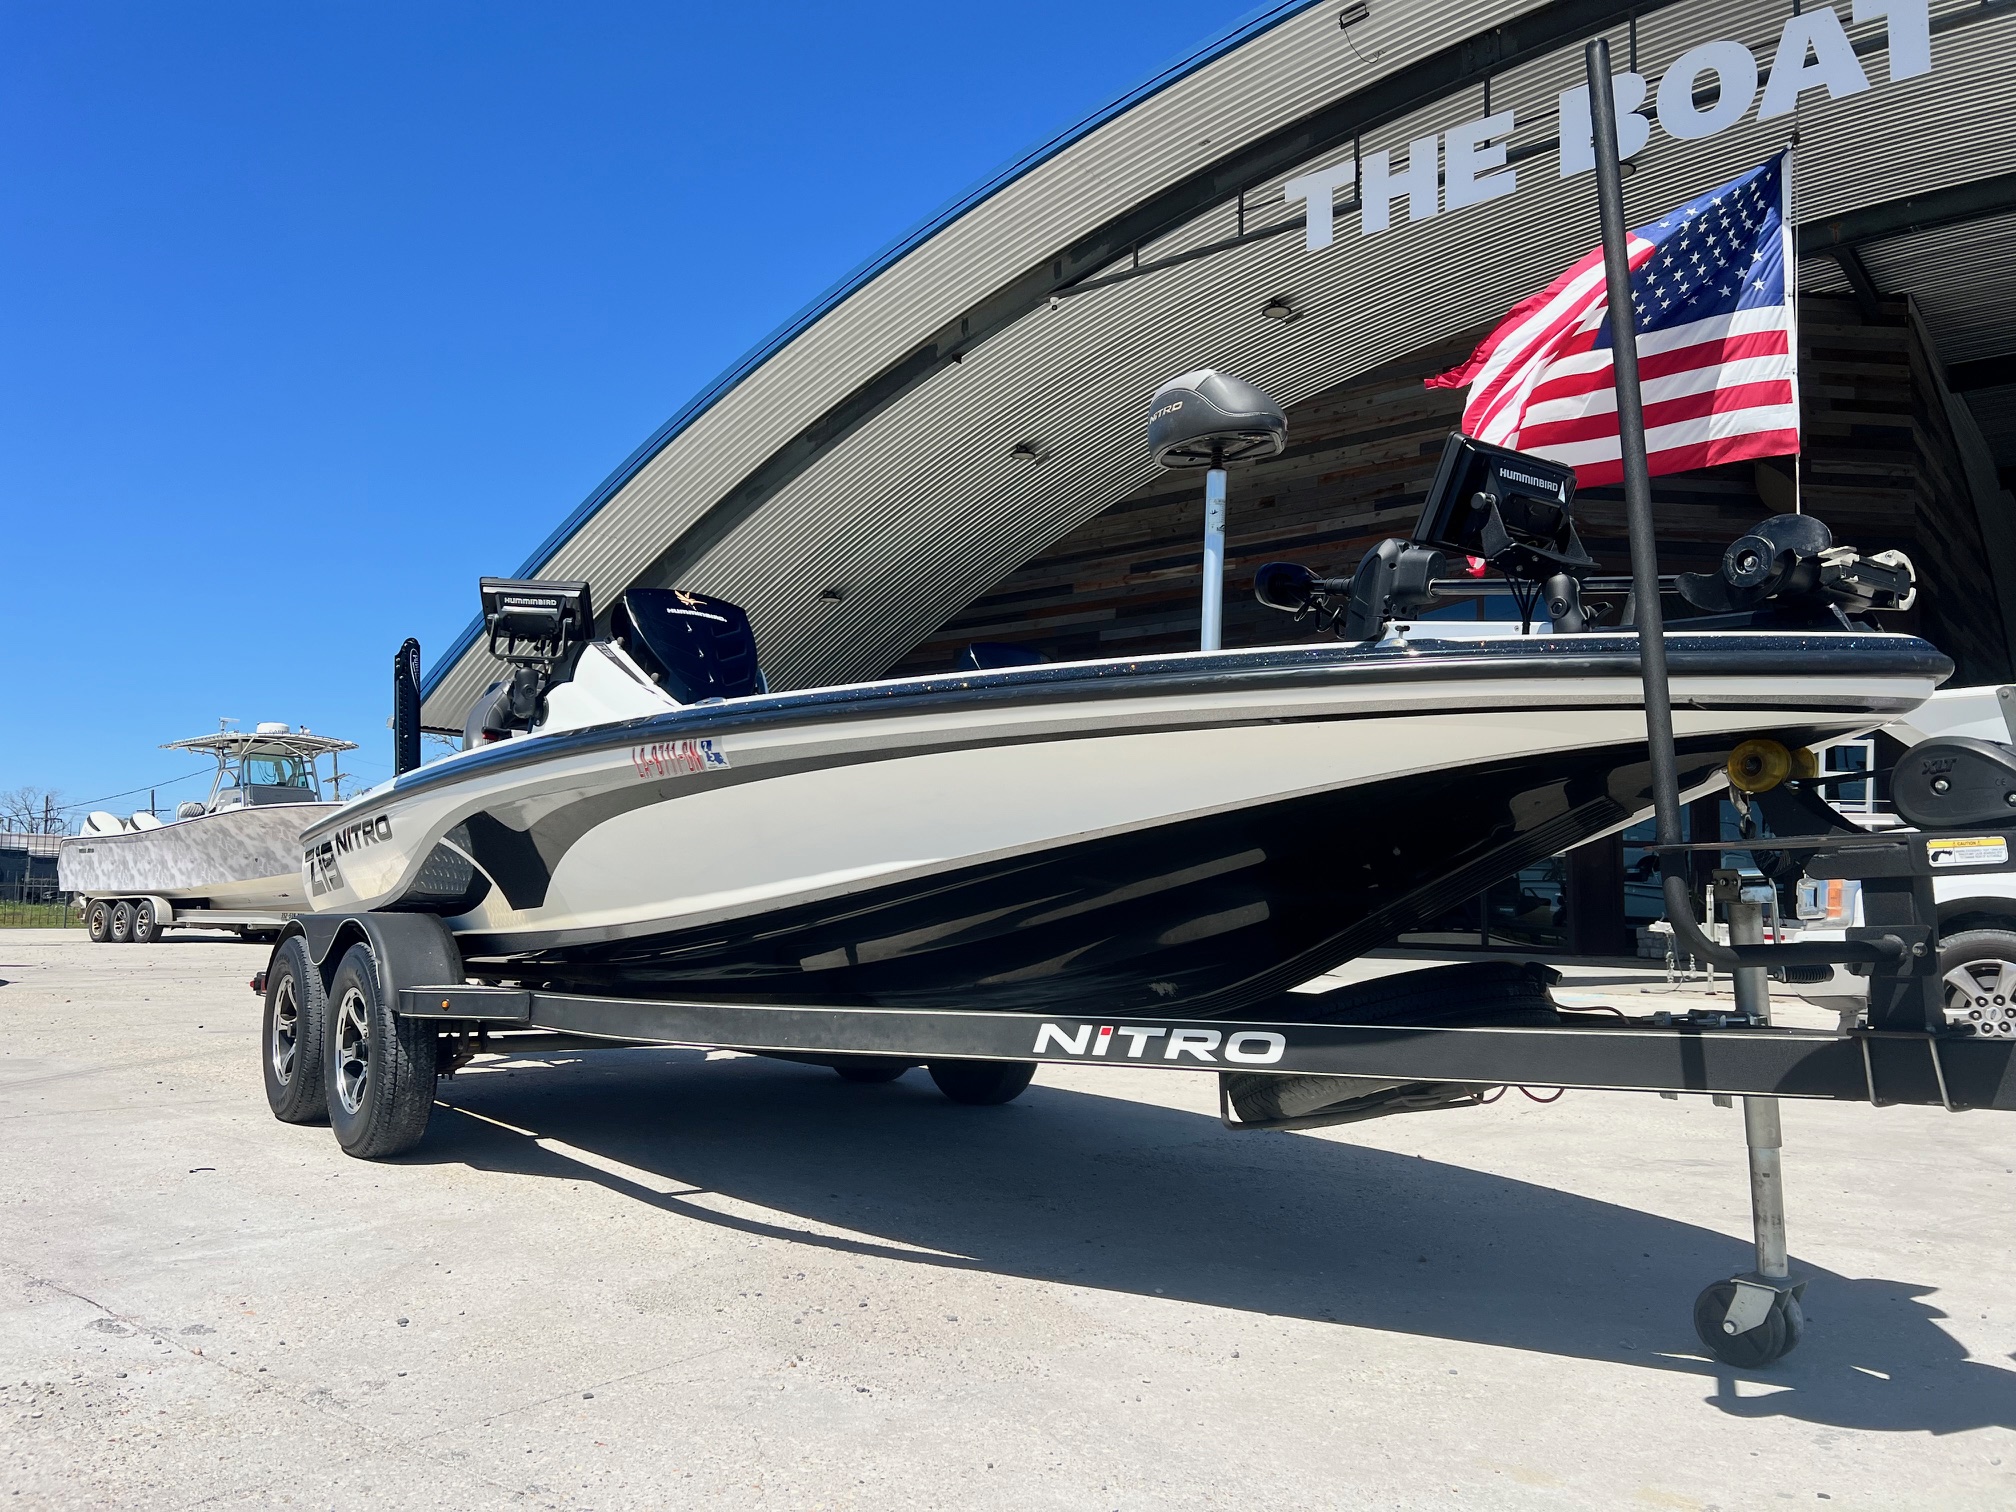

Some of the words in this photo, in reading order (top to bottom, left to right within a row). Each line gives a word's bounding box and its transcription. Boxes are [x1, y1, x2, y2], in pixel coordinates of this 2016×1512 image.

[1285, 110, 1516, 251] THE
[1559, 0, 1931, 178] BOAT
[1150, 401, 1183, 424] NITRO
[1500, 467, 1558, 492] HUMMINBIRD
[504, 597, 557, 606] HUMMINBIRD
[1922, 758, 1957, 775] XLT
[335, 814, 393, 856] NITRO
[1032, 1023, 1286, 1064] NITRO
